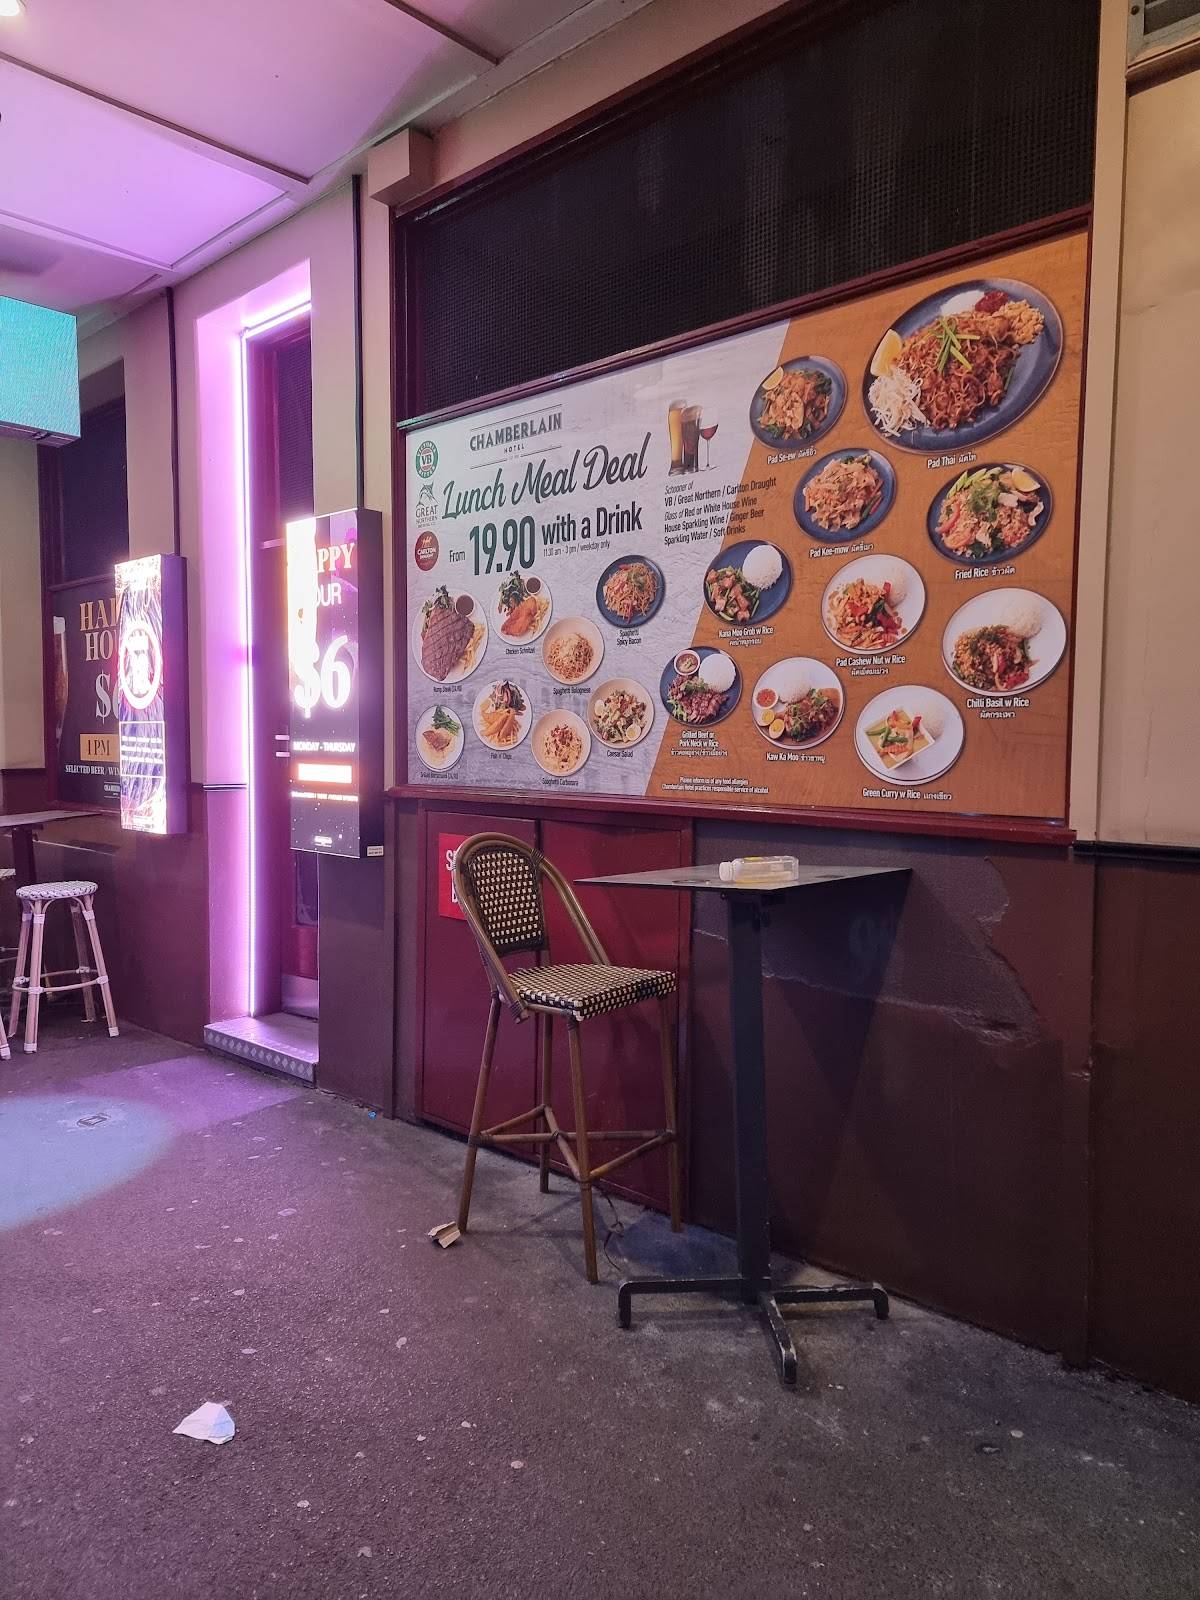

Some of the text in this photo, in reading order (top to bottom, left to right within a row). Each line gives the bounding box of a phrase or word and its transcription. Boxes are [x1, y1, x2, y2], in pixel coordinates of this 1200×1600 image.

[470, 413, 562, 451] CHAMBERLAIN
[504, 443, 525, 453] HOTEL
[421, 454, 432, 465] VB
[767, 454, 778, 465] Pad
[927, 454, 957, 469] Pad Thai
[442, 431, 652, 519] Lunch Meal Deal
[664, 497, 672, 506] VB
[677, 494, 694, 505] Great
[694, 489, 720, 501] Northern
[750, 478, 777, 490] Draught
[416, 505, 438, 518] GREAT
[684, 507, 696, 517] Red
[703, 503, 720, 514] White
[721, 500, 740, 511] House
[741, 497, 757, 507] Wine
[664, 523, 681, 533] House
[682, 518, 709, 531] Sparkling
[709, 516, 725, 525] Wine
[729, 511, 749, 523] Ginger
[750, 509, 764, 519] Beer
[449, 501, 643, 576] From 19.90 with a Drink
[664, 534, 690, 547] Sparkling
[690, 531, 708, 541] Water
[713, 527, 726, 538] Soft
[726, 525, 746, 536] Drinks
[316, 542, 355, 573] PPY
[417, 547, 437, 556] CARLTON
[809, 545, 850, 558] Pad Kee-mow
[955, 567, 989, 580] Fried Rice
[732, 628, 743, 637] Moo
[743, 627, 756, 636] Grob
[762, 625, 774, 635] Rice
[85, 629, 118, 662] HO
[835, 657, 848, 667] Pad
[848, 656, 872, 666] Cashew
[872, 655, 884, 665] Nut
[891, 653, 906, 664] Rice
[294, 635, 351, 719] $6
[966, 696, 1030, 708] Chilli Basil w Rice
[292, 741, 320, 751] MONDAY
[323, 742, 356, 753] THURSDAY
[679, 739, 690, 747] Pork
[690, 739, 702, 747] Neck
[708, 739, 719, 748] Rice
[766, 752, 799, 761] Kaw Ka Moo
[65, 764, 91, 774] SELECTED
[91, 765, 105, 775] BEER
[862, 787, 921, 800] Green Curry w Rice
